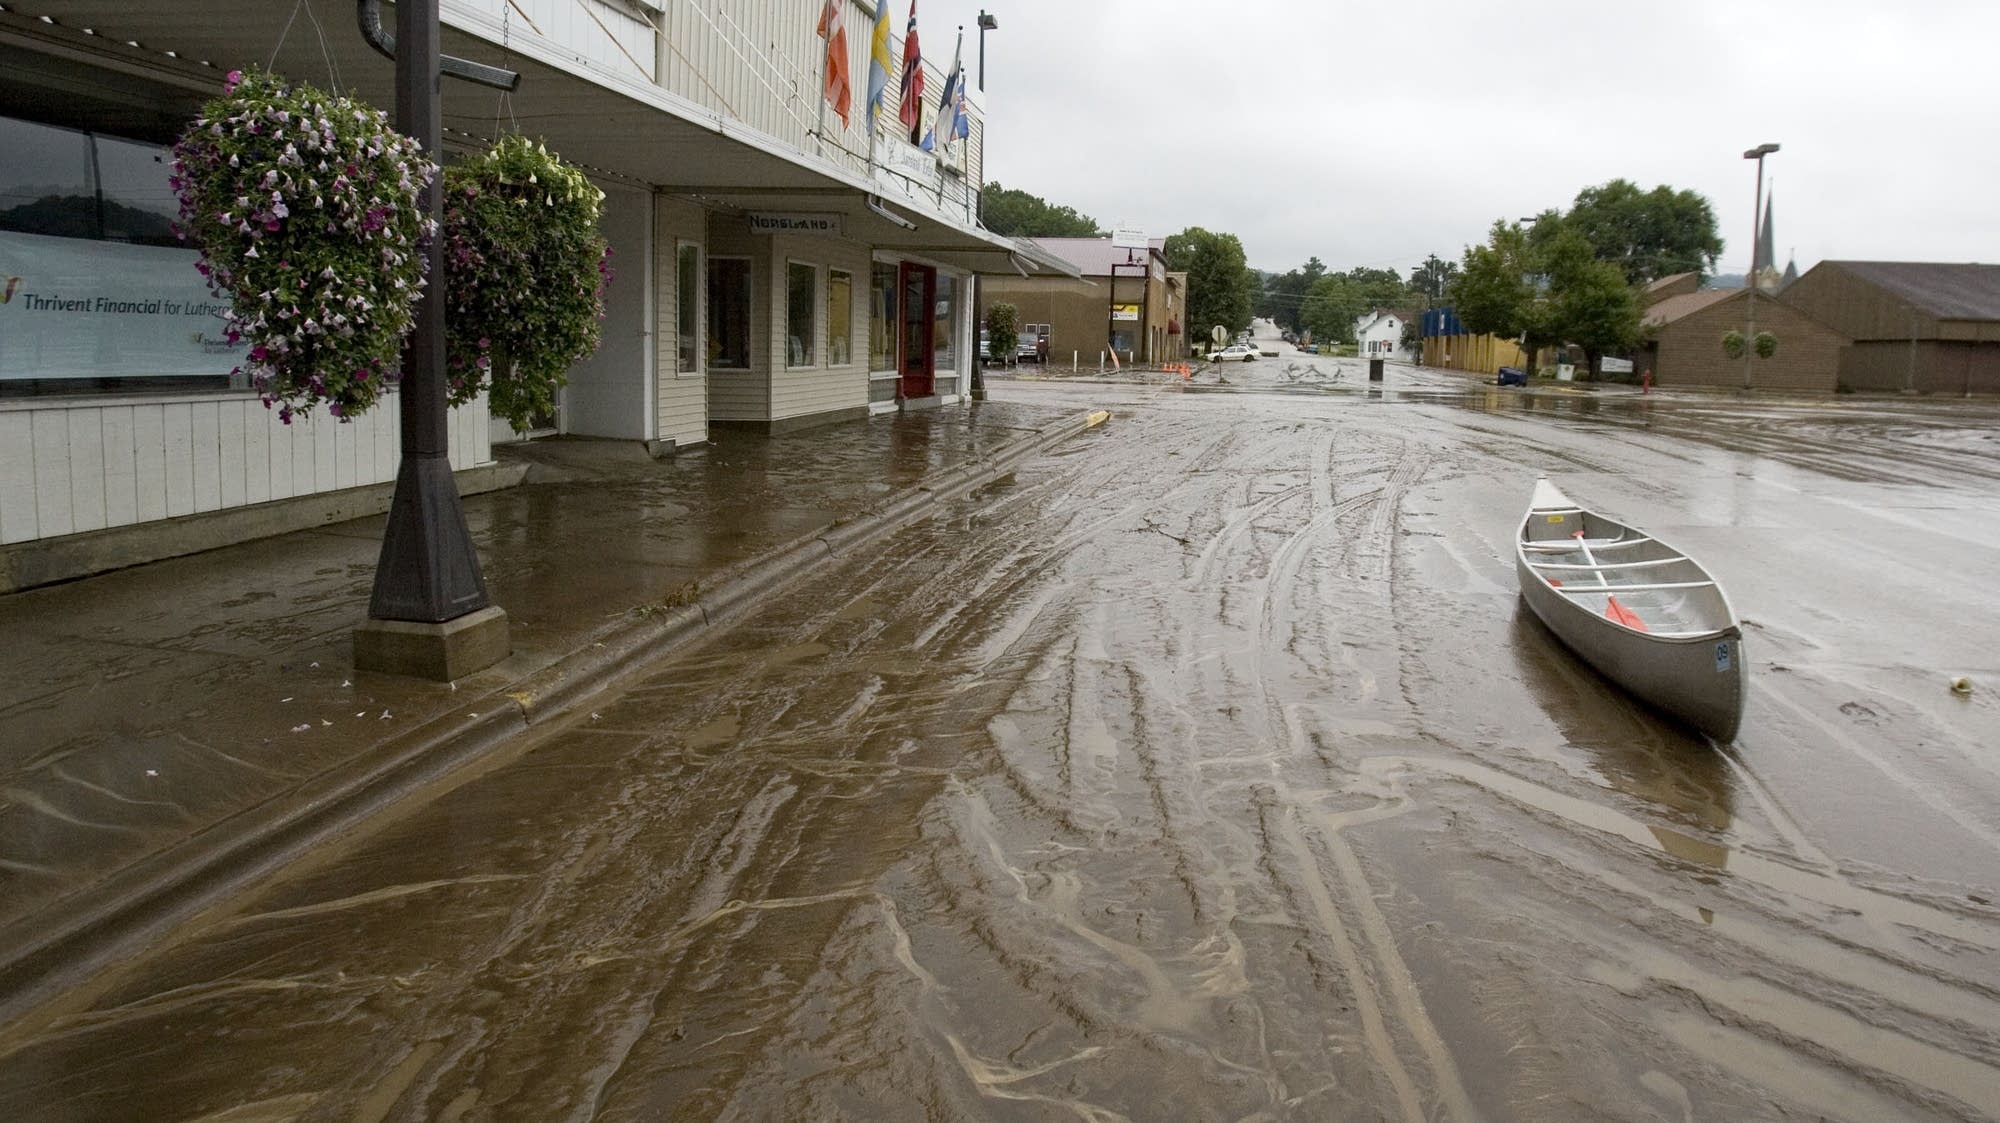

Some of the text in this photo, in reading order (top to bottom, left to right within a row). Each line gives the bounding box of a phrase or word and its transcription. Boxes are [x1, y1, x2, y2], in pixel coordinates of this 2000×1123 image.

[24, 294, 230, 316] Thrivent Financial for Luthera
